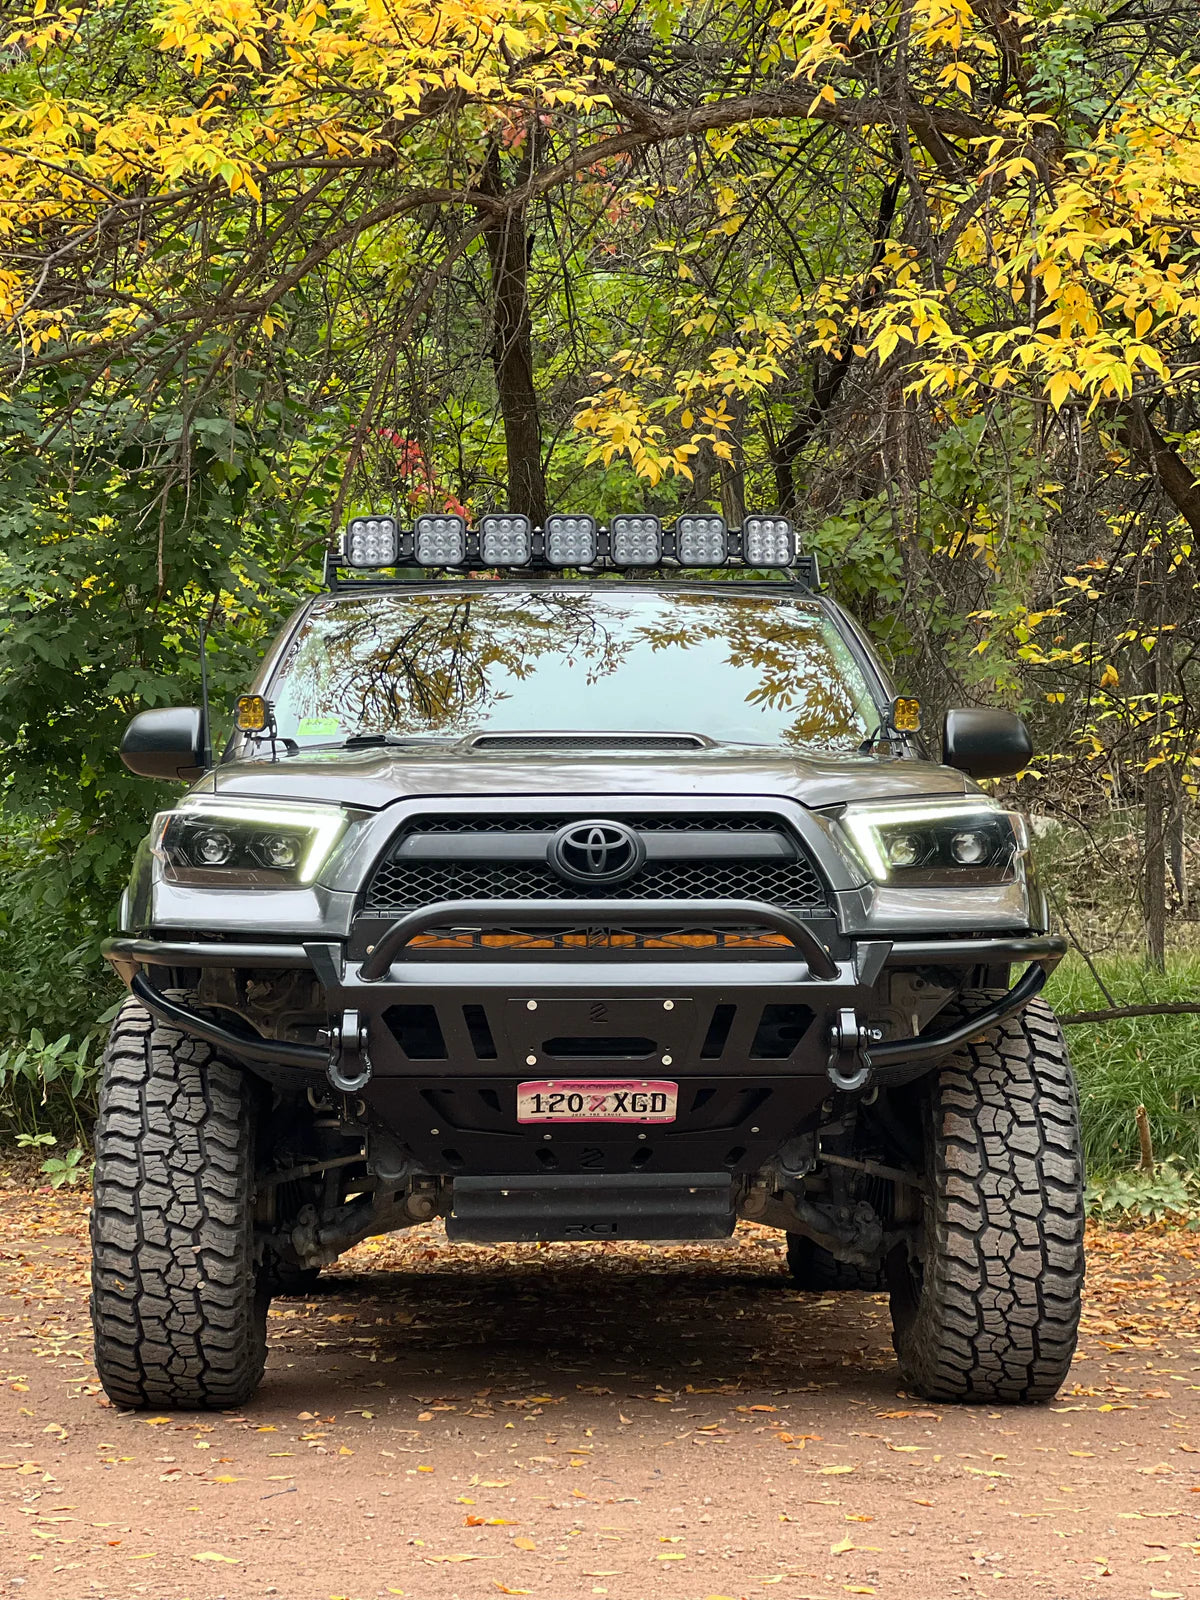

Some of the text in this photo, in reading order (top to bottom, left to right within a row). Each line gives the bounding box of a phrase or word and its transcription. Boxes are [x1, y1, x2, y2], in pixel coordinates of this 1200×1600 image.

[530, 1091, 667, 1114] 120 XGD
[565, 1223, 617, 1235] RCI
